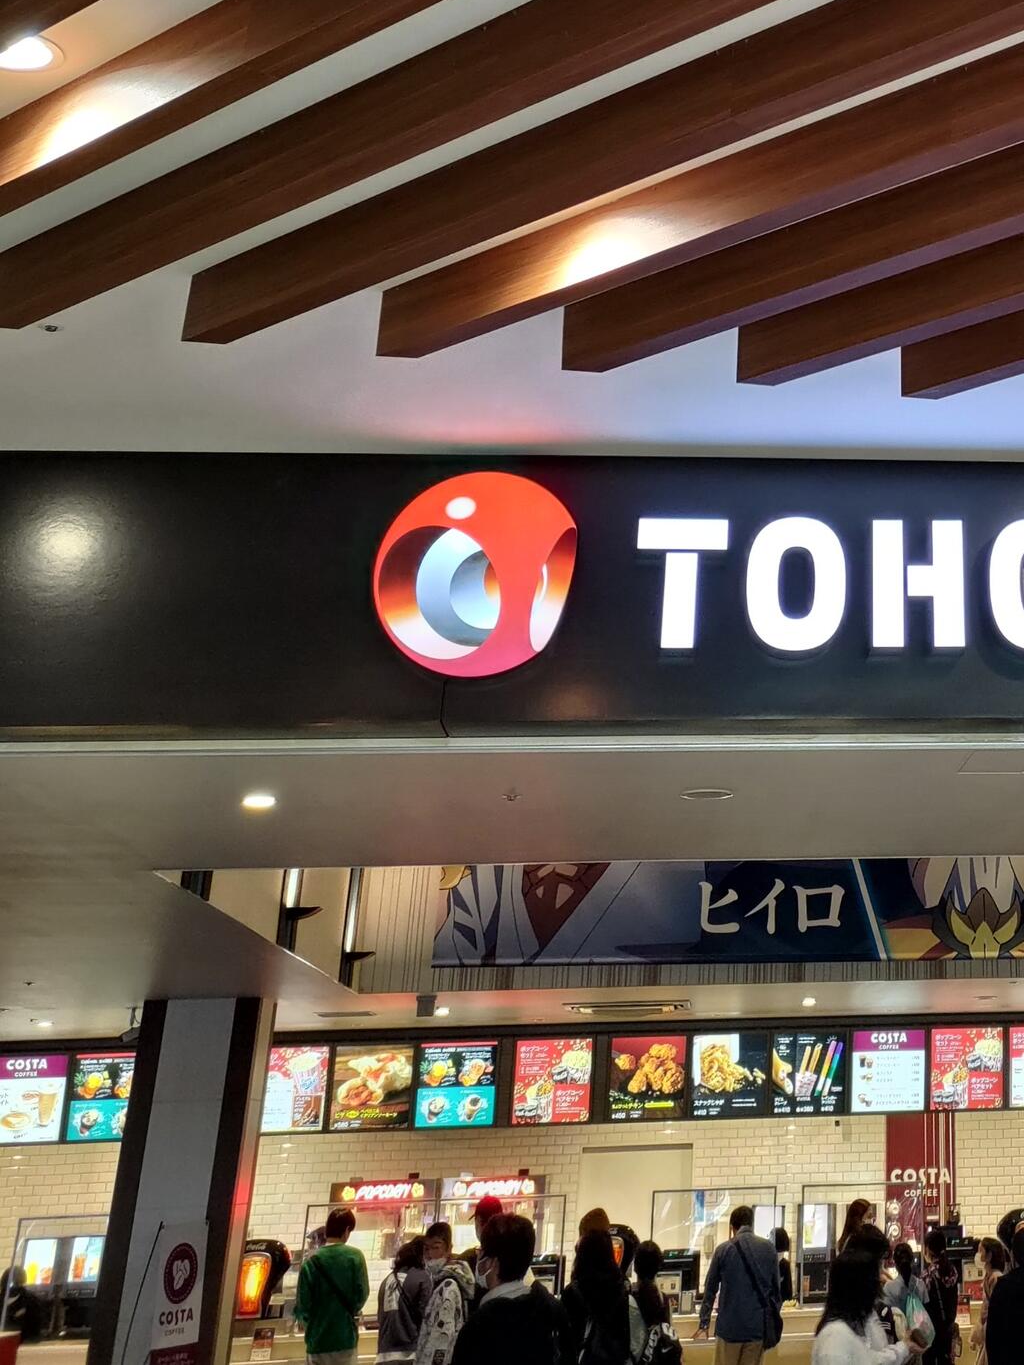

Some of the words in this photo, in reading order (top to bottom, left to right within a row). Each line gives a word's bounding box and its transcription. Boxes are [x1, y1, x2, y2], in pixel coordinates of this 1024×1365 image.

[699, 878, 845, 934] ヒイロ
[870, 1032, 907, 1044] COSTA
[6, 1058, 48, 1070] COSTA
[890, 1168, 951, 1185] COSTA
[355, 1183, 411, 1200] POPCORN
[904, 1189, 939, 1197] COFFEE
[159, 1307, 194, 1326] COSTA
